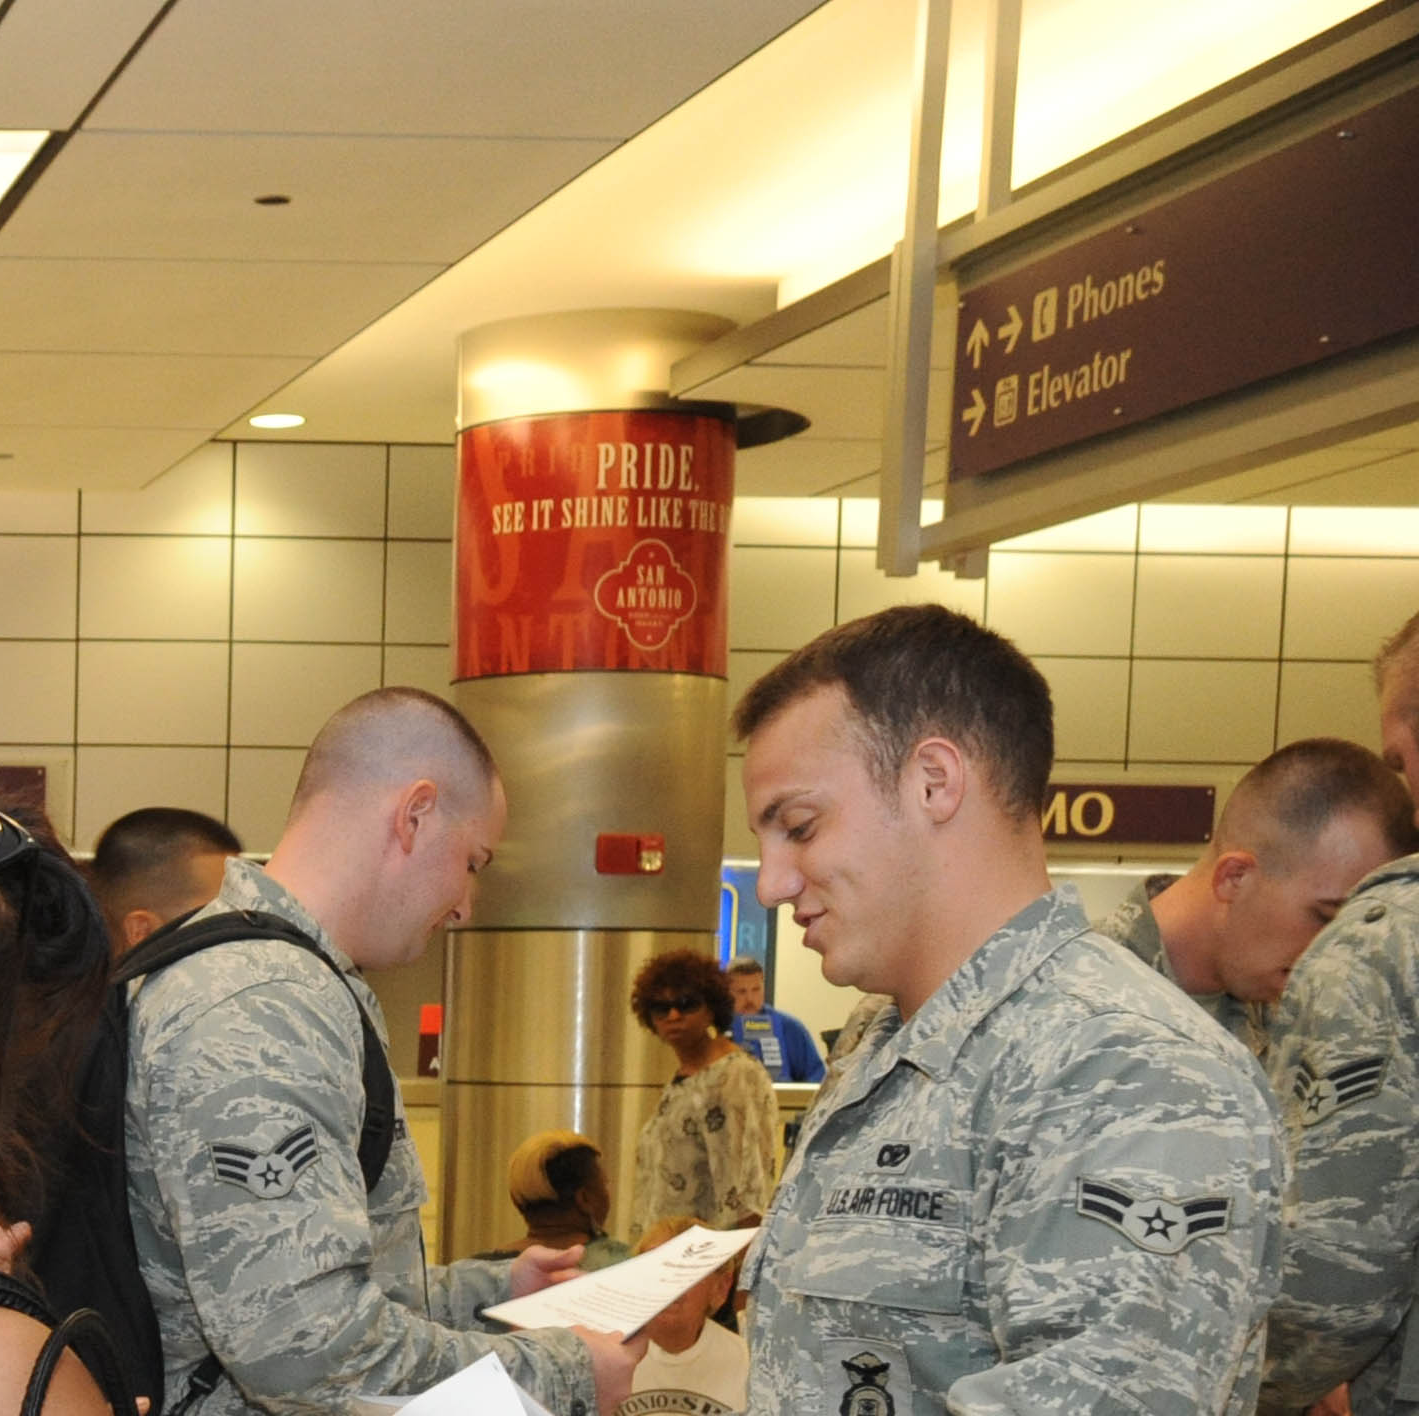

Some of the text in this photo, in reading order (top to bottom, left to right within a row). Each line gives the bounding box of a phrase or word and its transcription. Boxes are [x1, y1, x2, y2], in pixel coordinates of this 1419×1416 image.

[1066, 258, 1164, 329] Phones
[1027, 347, 1131, 417] Elevator
[596, 442, 700, 492] PRIDE.
[492, 500, 525, 534] SEE
[531, 499, 554, 531] IT
[561, 496, 629, 530] SHINE
[637, 496, 683, 530] LIKE
[636, 564, 664, 586] SAN
[616, 586, 683, 609] ANTONIO
[876, 1187, 944, 1221] FORCE
